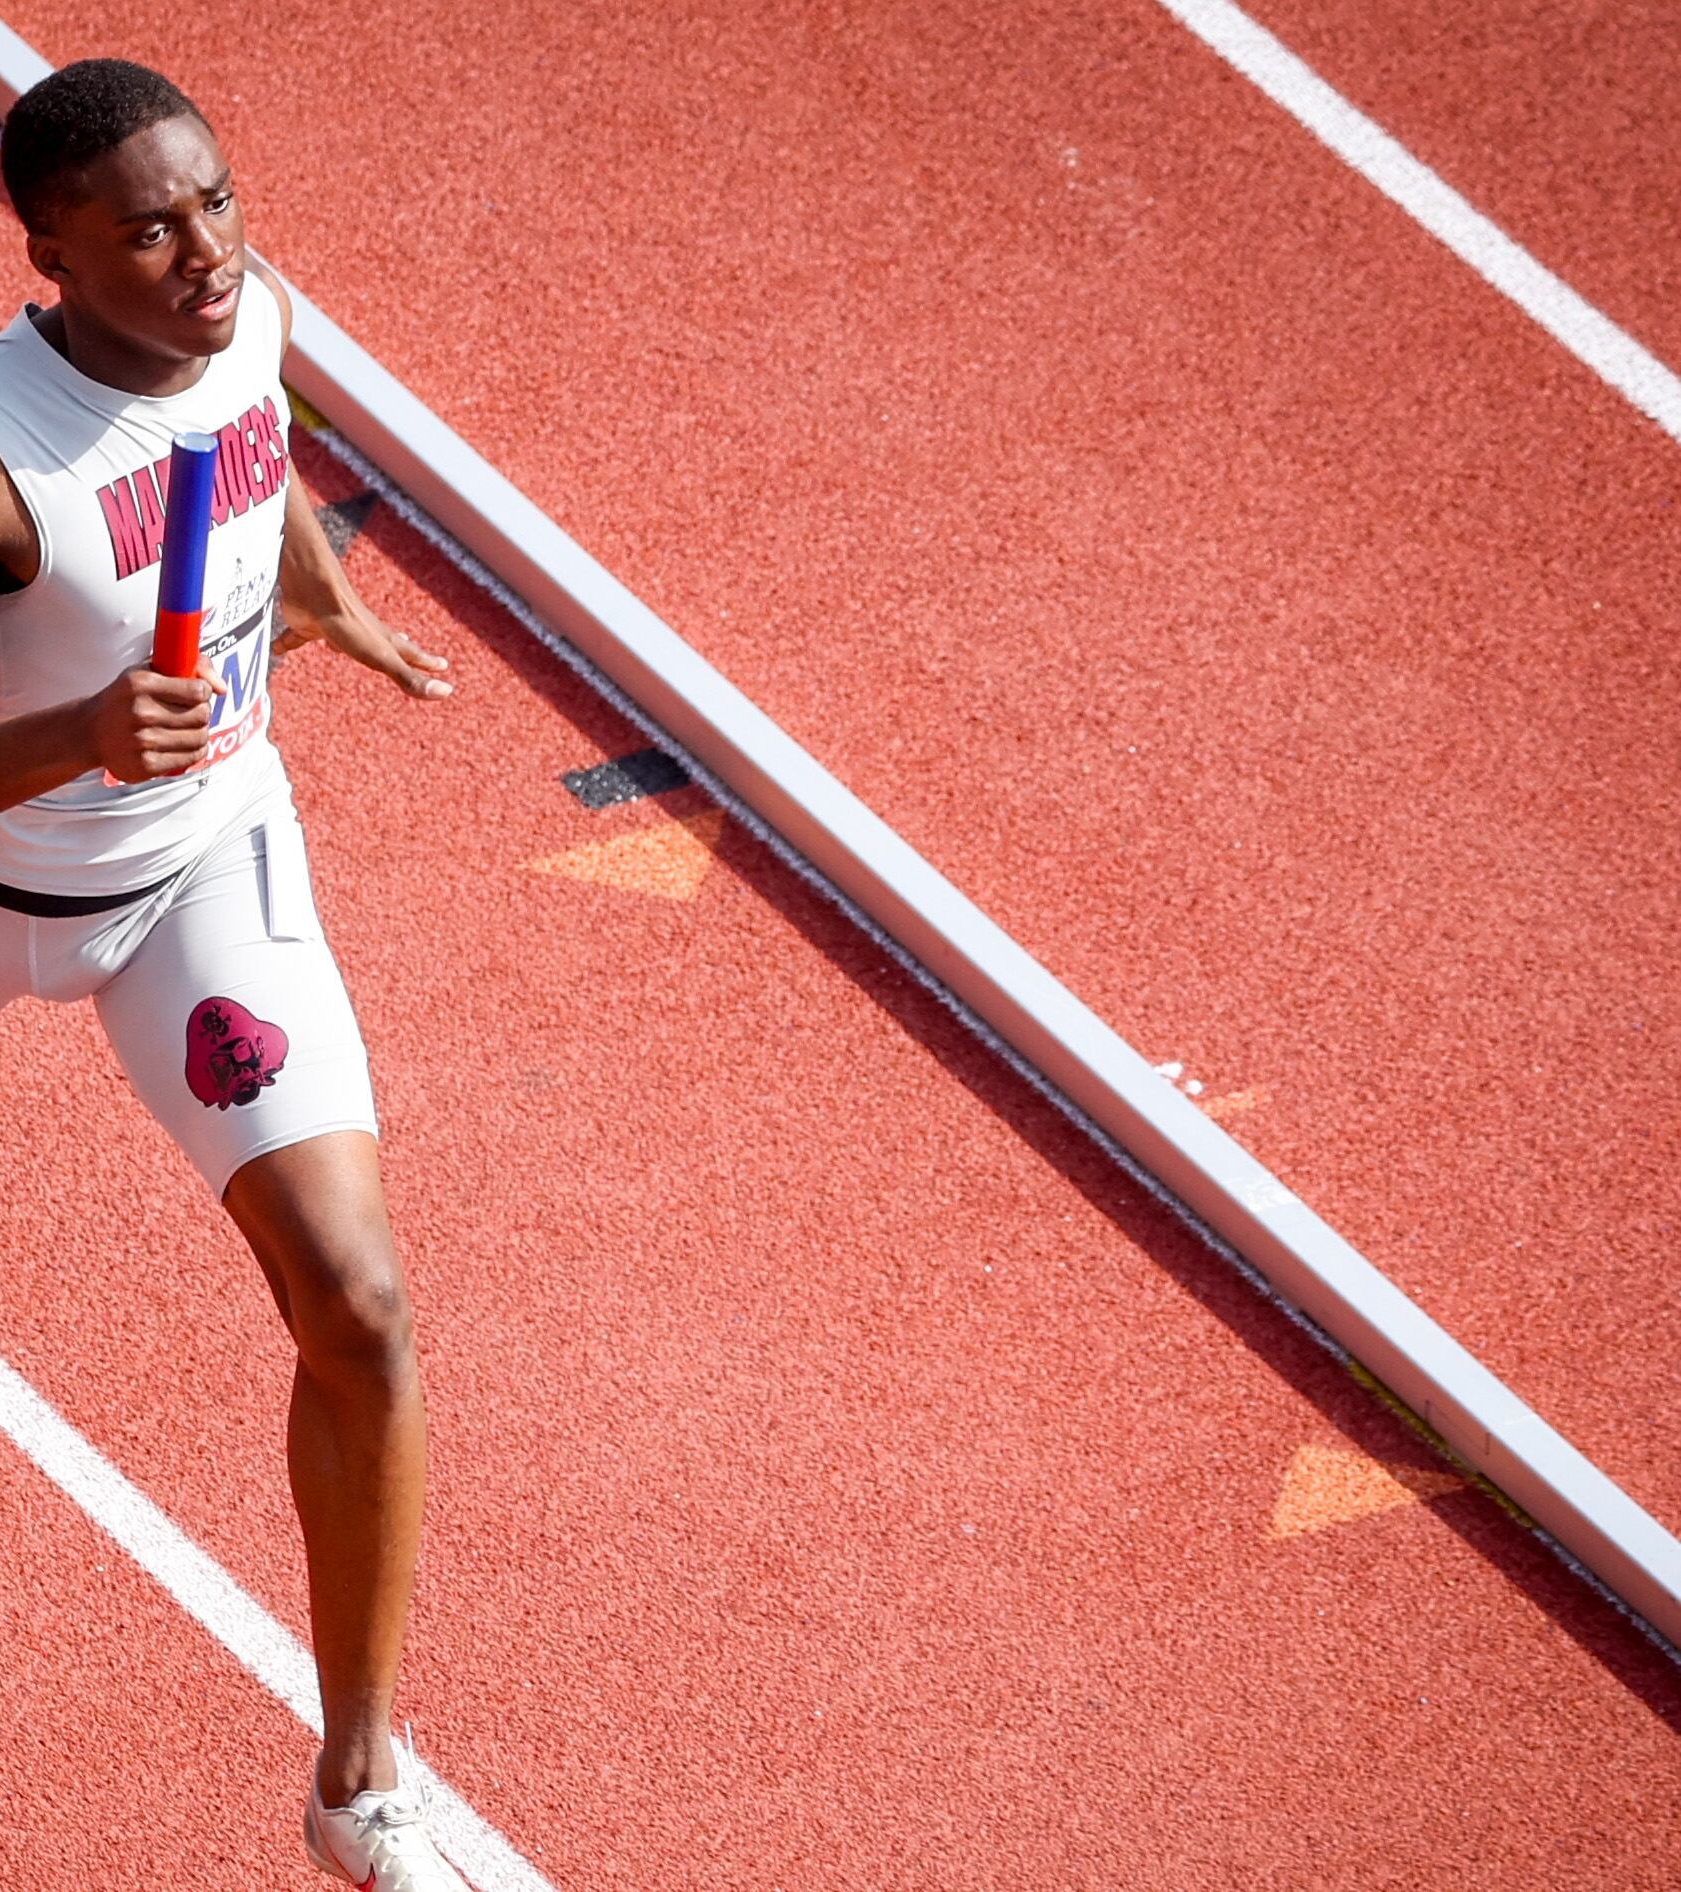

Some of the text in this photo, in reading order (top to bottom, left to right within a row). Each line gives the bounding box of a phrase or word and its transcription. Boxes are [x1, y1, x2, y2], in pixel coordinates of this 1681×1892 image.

[95, 395, 288, 581] MAUDERS
[226, 567, 268, 608] PENN
[206, 712, 255, 760] YOTA
